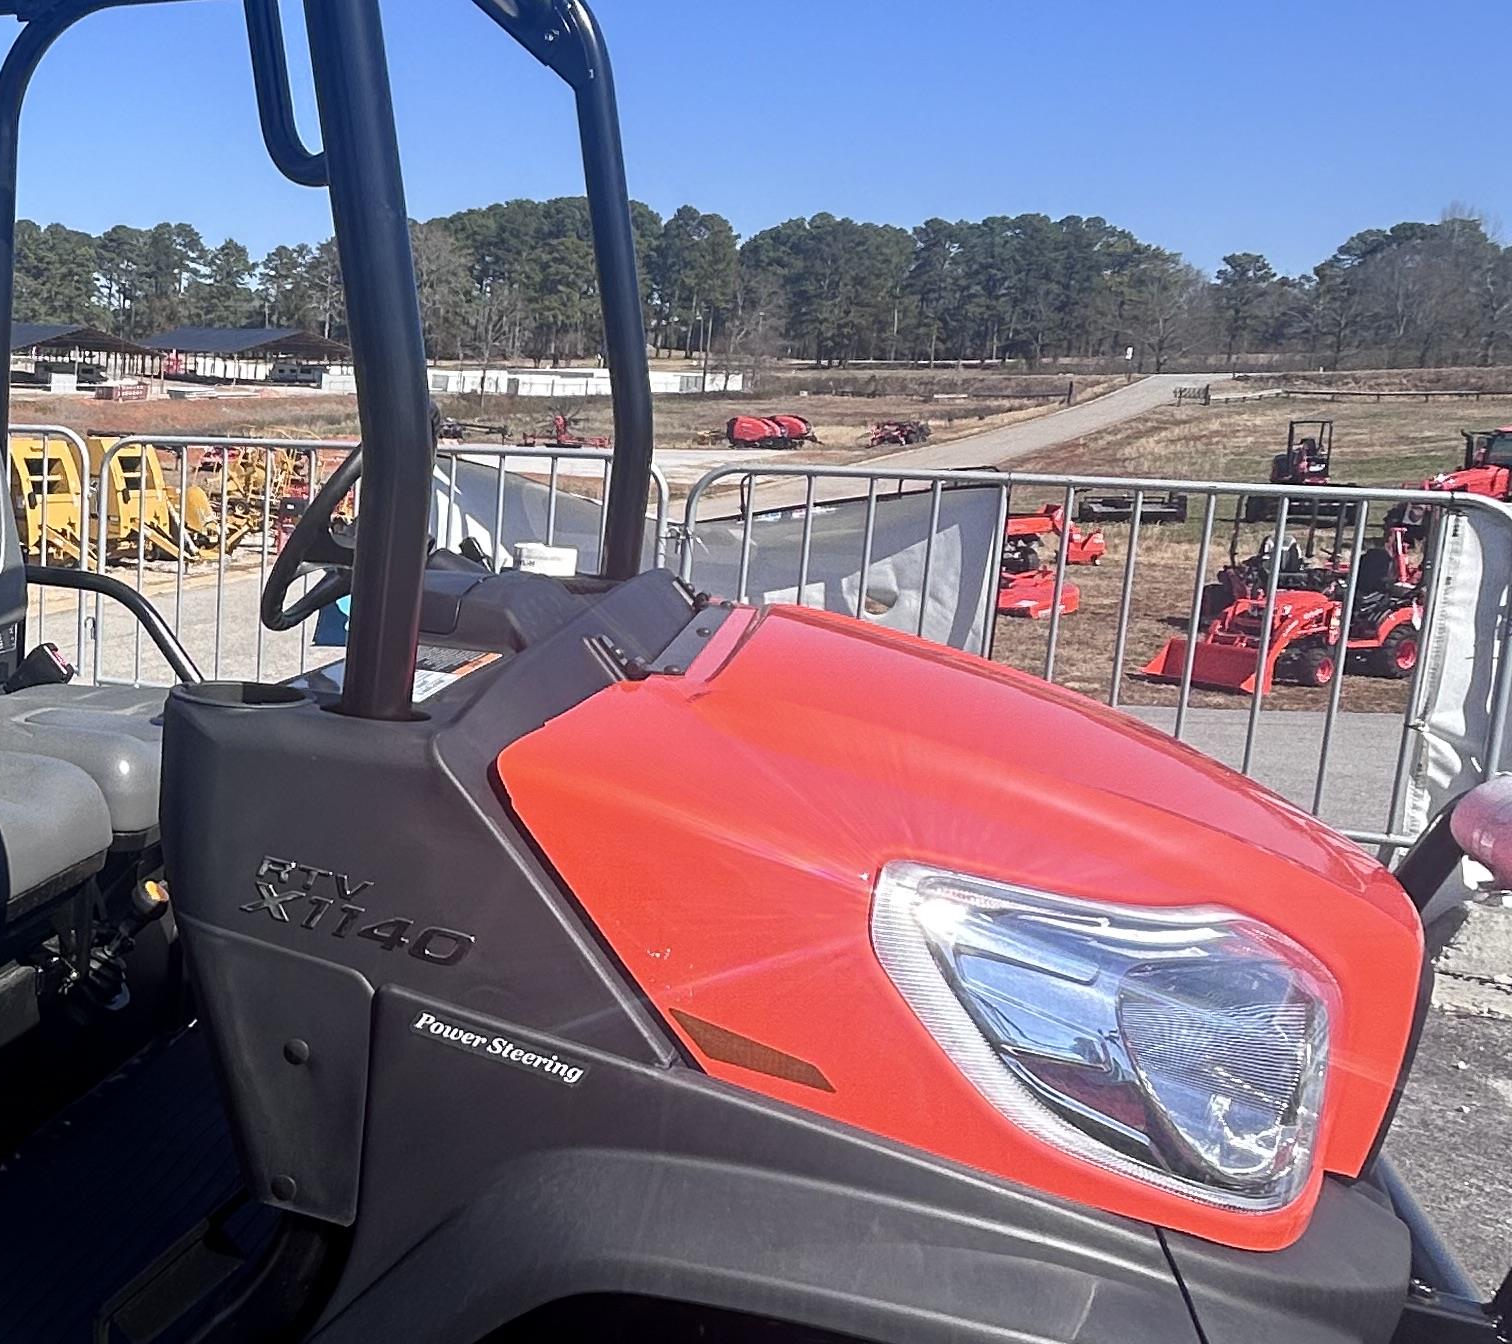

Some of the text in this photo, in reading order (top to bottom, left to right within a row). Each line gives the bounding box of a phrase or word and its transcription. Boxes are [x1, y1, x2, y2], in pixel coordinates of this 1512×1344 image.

[256, 855, 376, 901] RTV
[239, 881, 477, 966] X1140
[413, 1012, 585, 1085] Power Steering
